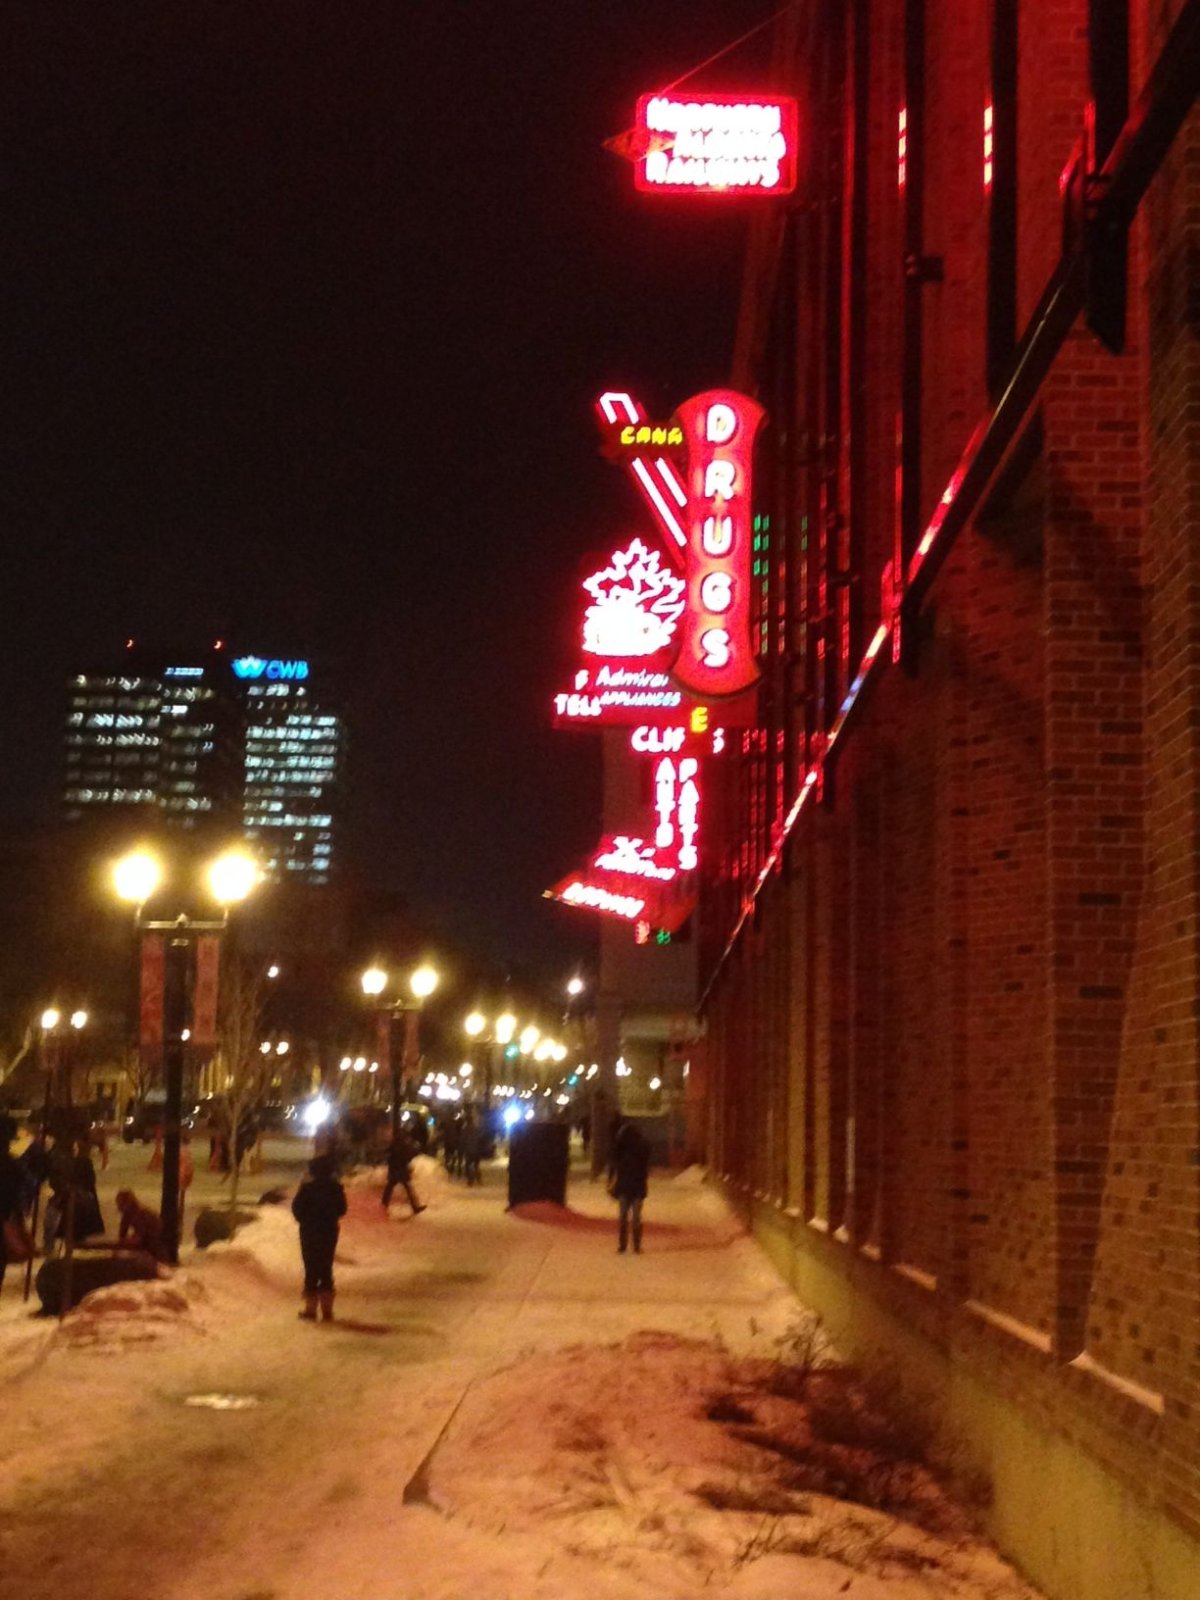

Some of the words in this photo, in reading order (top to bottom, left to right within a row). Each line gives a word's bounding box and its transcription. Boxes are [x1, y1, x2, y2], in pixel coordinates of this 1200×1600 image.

[621, 426, 683, 445] CANA
[702, 404, 740, 667] DRUGS
[266, 660, 308, 679] CWB
